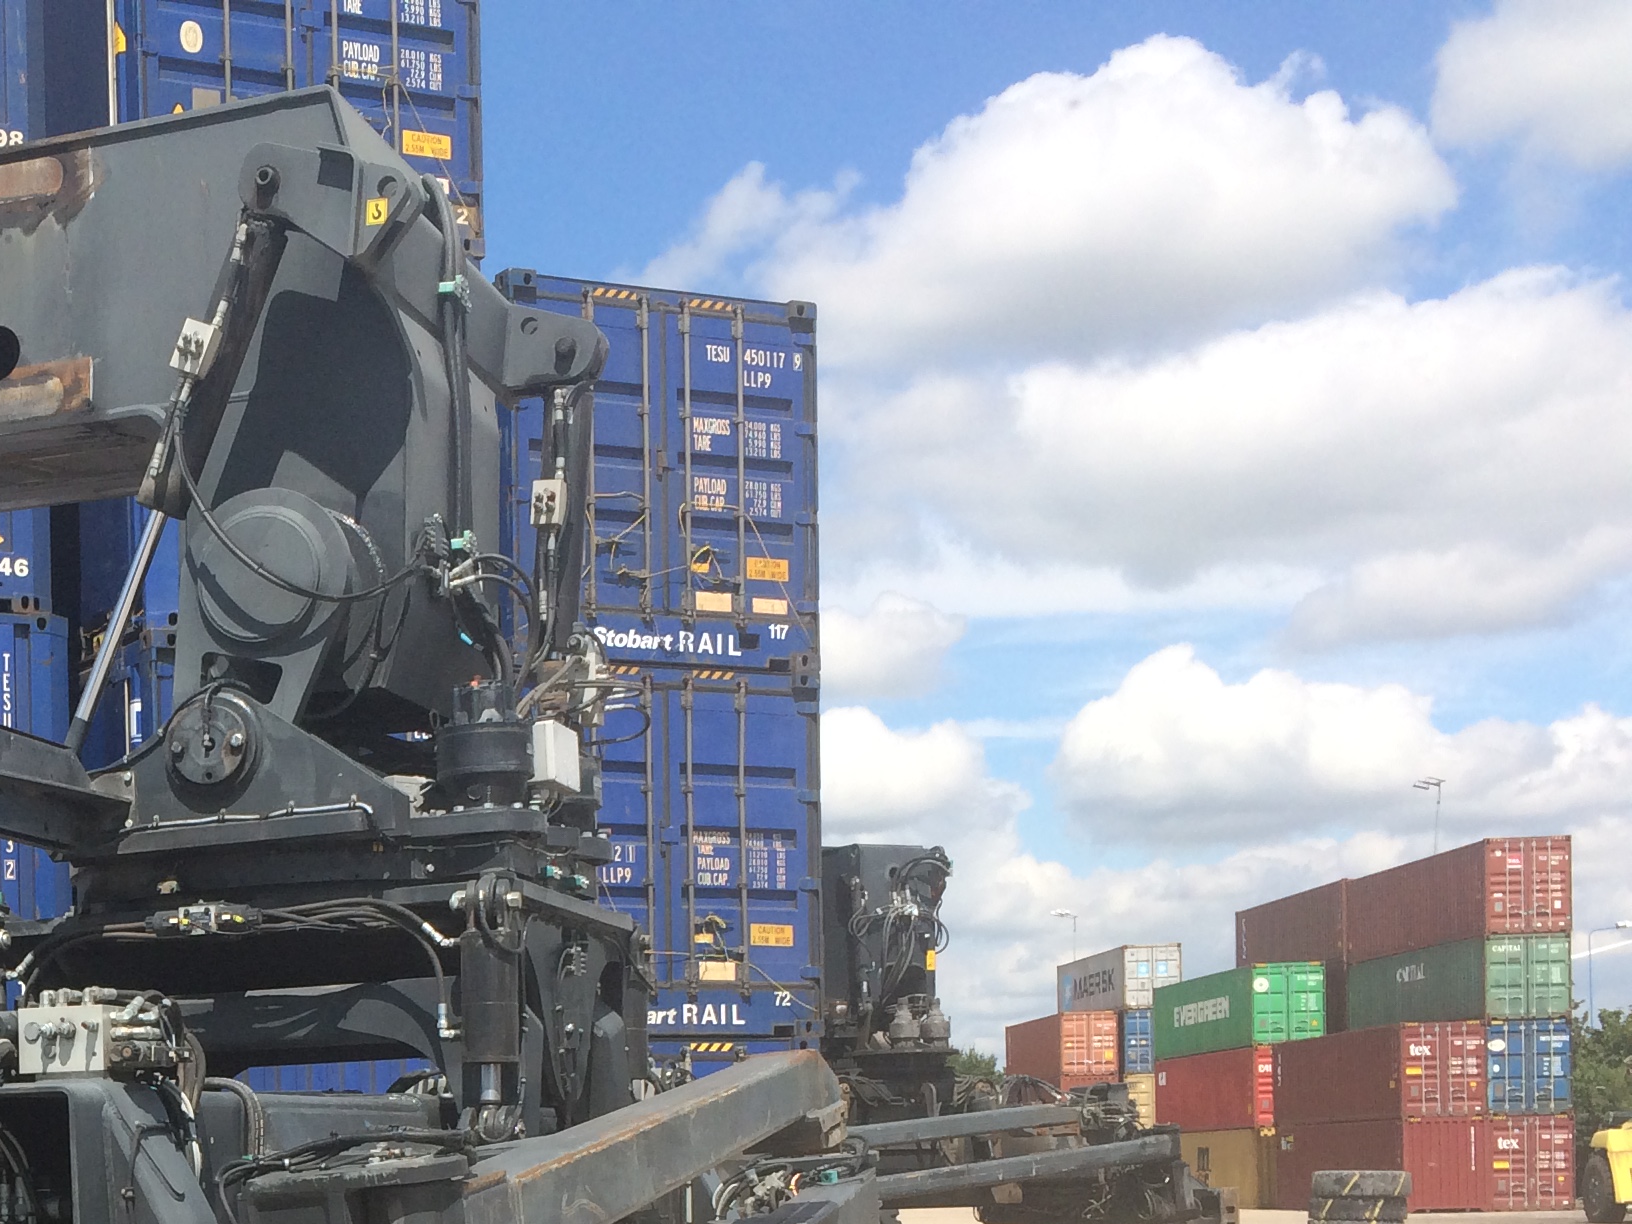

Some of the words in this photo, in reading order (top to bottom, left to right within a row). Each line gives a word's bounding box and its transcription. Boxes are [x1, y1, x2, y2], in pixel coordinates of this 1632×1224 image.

[343, 0, 362, 14] TARE
[401, 12, 424, 25] 13.210
[342, 40, 380, 62] PAYLOAD
[706, 345, 730, 362] TESU
[744, 349, 785, 368] 450117
[744, 370, 771, 388] LLP9
[693, 417, 730, 435] MAXGROSS
[693, 434, 711, 451] TARE
[694, 477, 726, 495] PAYLOAD
[593, 626, 673, 650] Stobart
[679, 631, 741, 656] RAIL
[768, 624, 789, 640] 117
[697, 857, 730, 870] PAYLOAD
[602, 867, 631, 884] LLP9
[1074, 968, 1115, 1001] MAERSK
[774, 992, 791, 1006] 72
[682, 1003, 745, 1025] RAIL
[1174, 995, 1229, 1028] EVERGREEN
[1409, 1043, 1432, 1056] tex
[1498, 1137, 1520, 1149] tex
